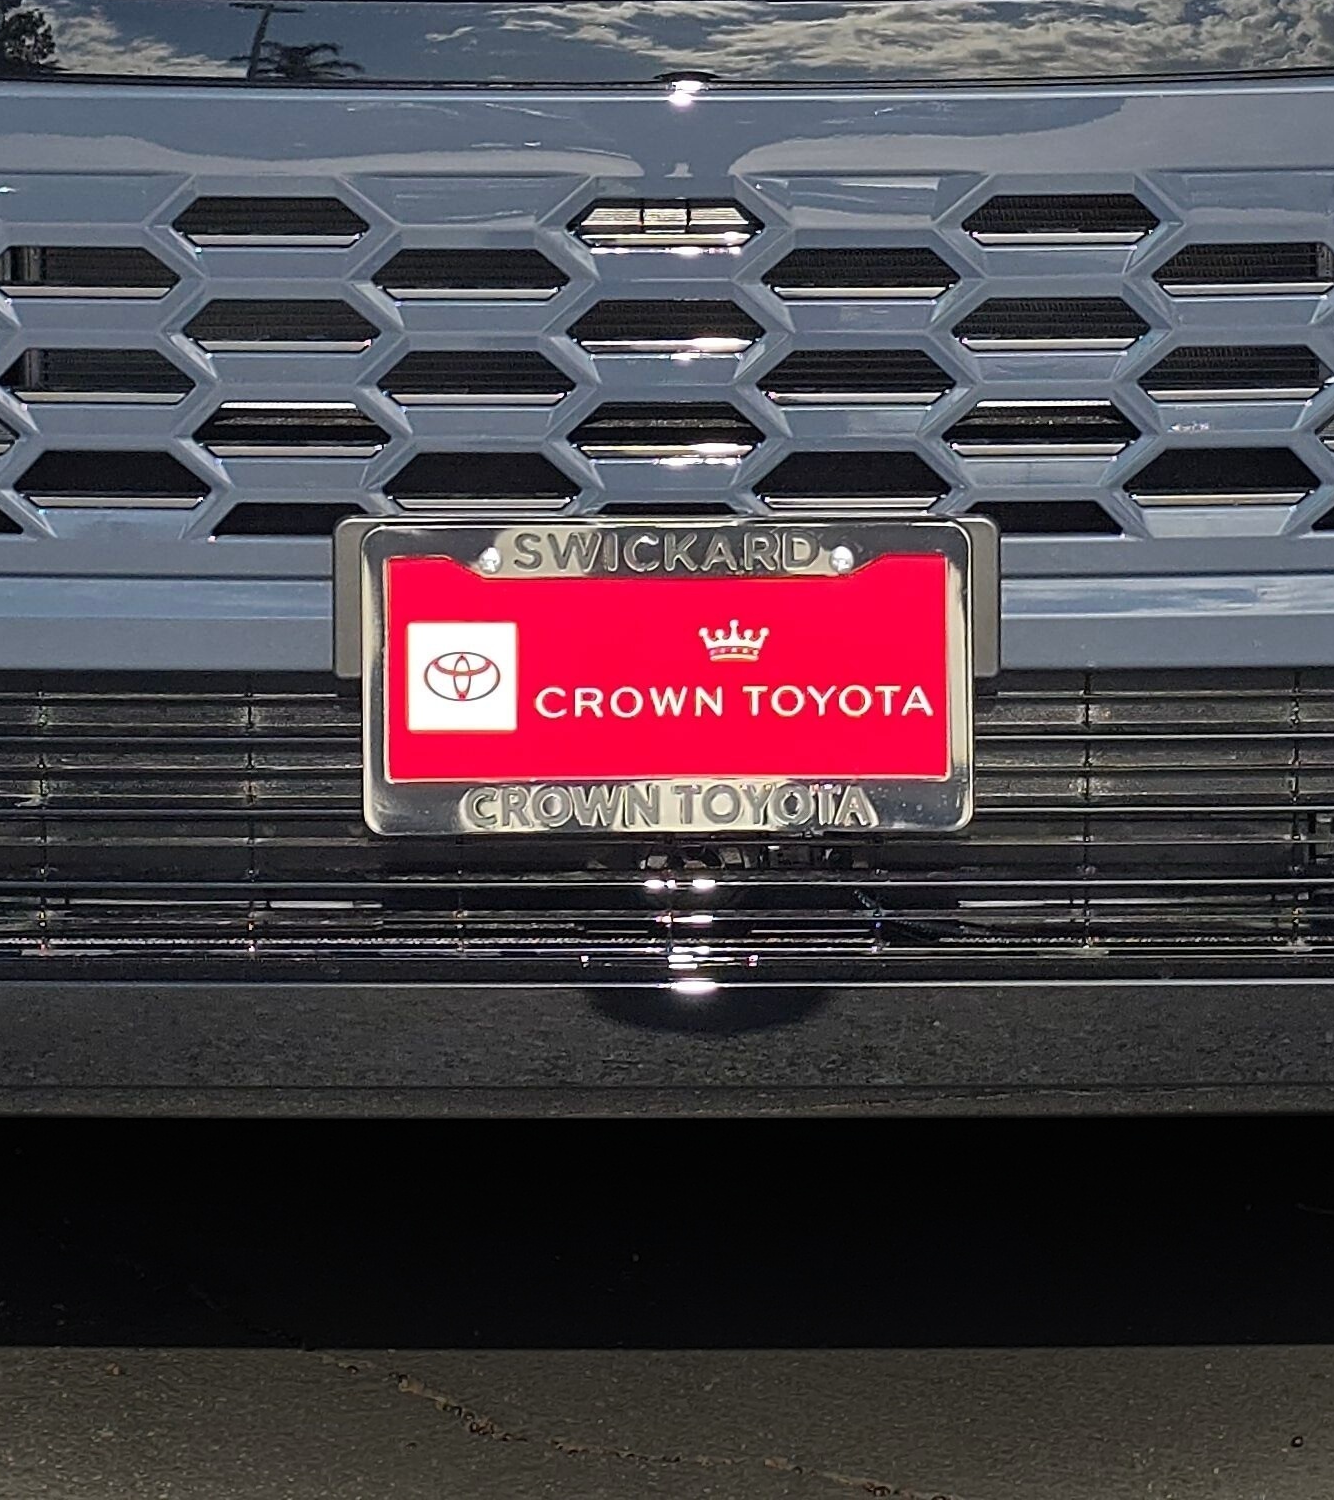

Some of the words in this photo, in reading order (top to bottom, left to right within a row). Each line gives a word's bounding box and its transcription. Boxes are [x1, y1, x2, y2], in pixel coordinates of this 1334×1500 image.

[513, 532, 821, 573] SWICKARD
[534, 685, 724, 719] CROWN
[742, 684, 934, 717] TOYOTA
[465, 786, 657, 828] CROWN
[670, 784, 877, 828] TOYOTA
